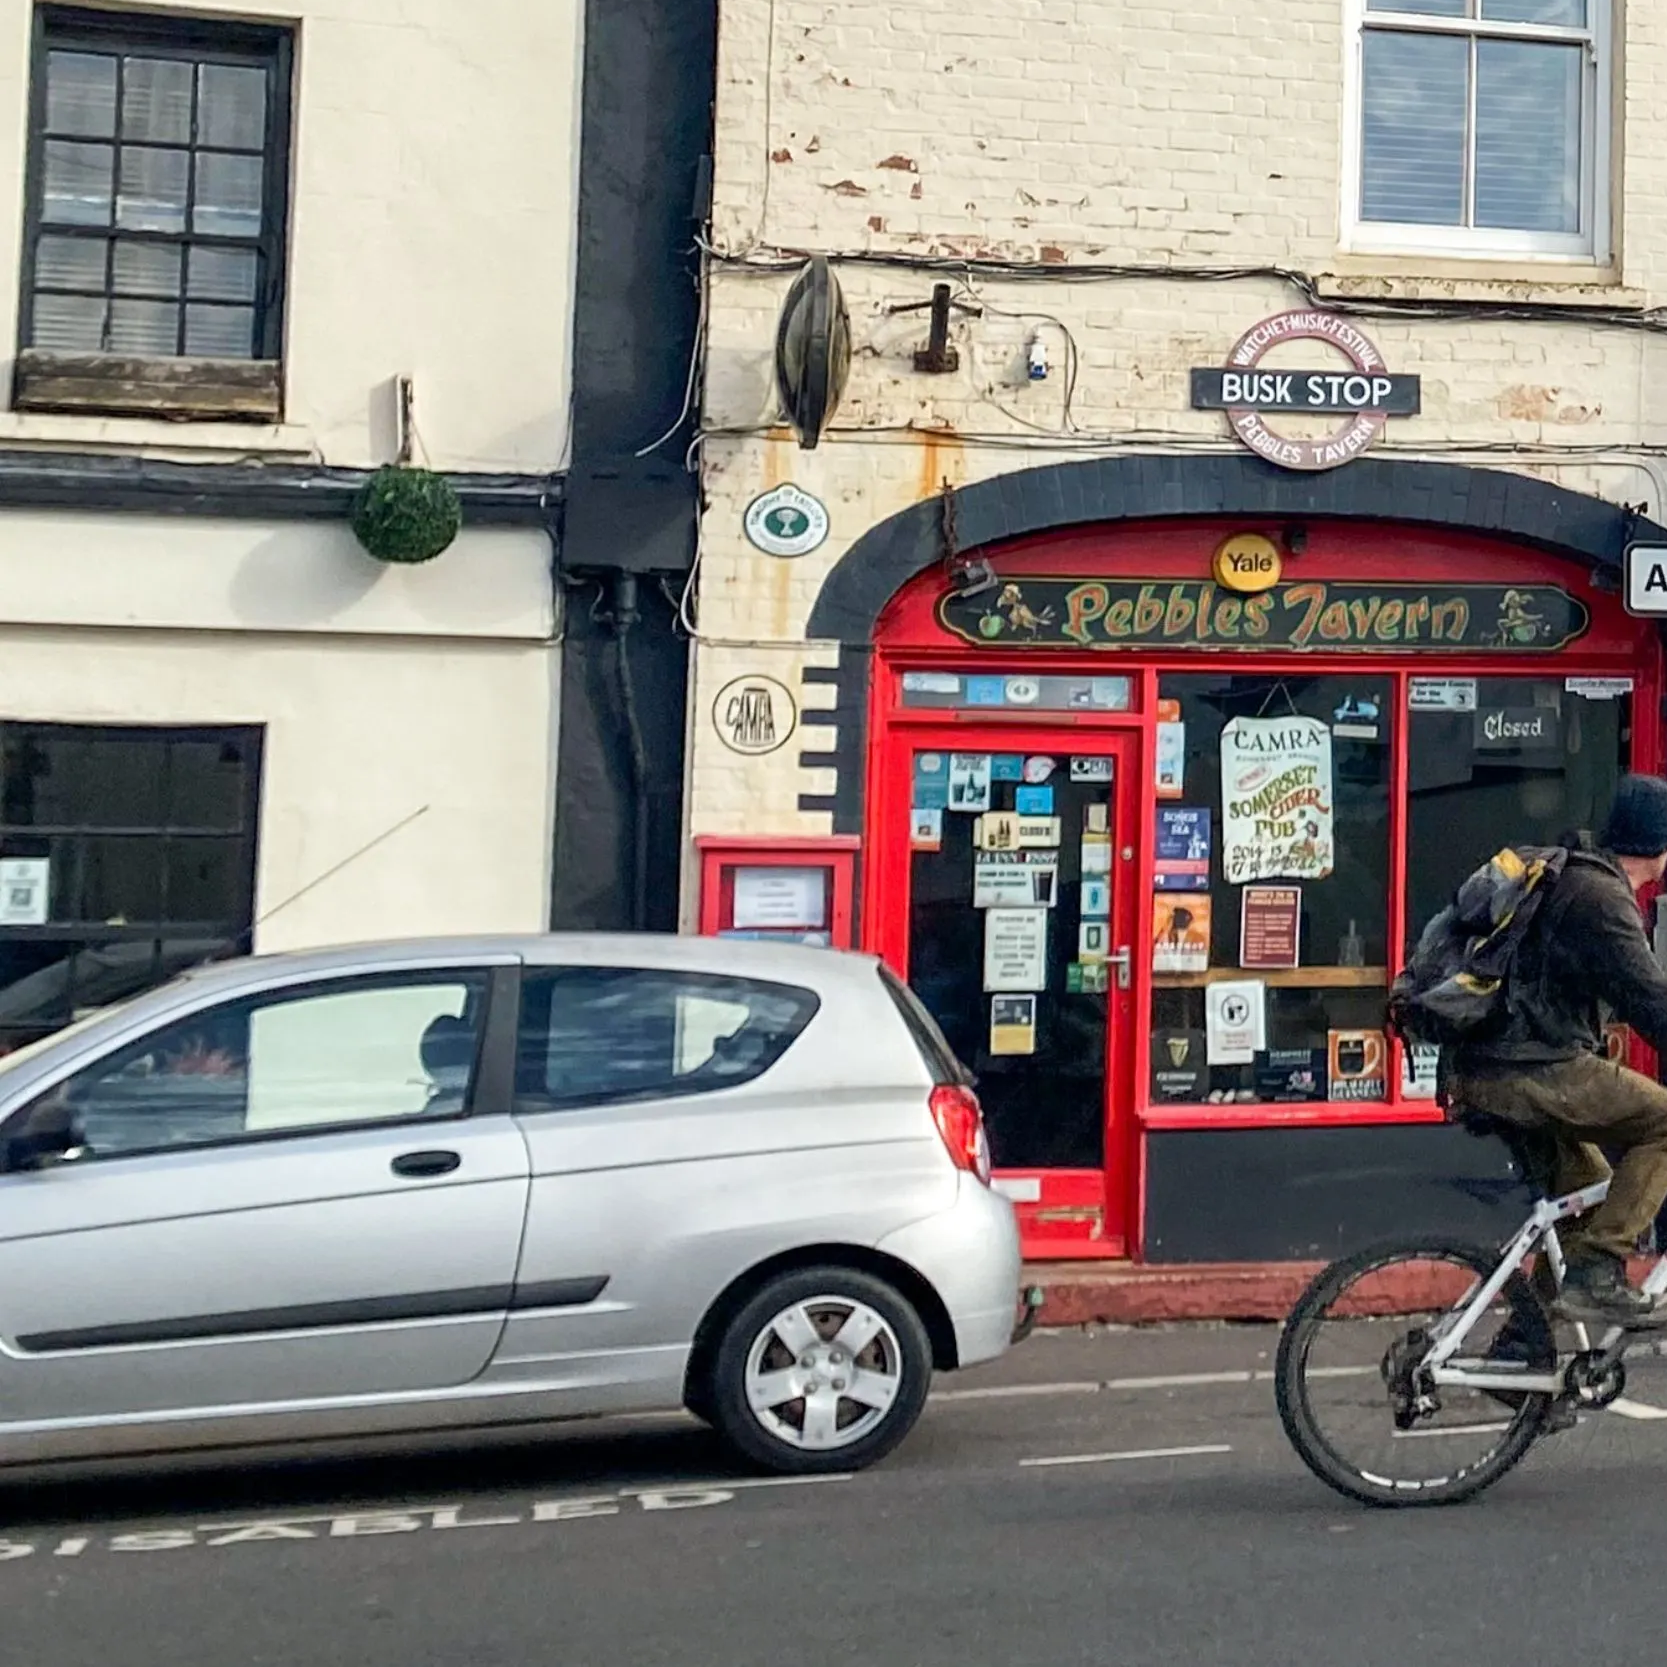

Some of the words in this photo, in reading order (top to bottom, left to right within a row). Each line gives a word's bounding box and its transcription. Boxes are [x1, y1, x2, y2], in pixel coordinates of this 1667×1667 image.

[1330, 320, 1380, 373] FESTIVAL
[1221, 373, 1293, 404] BUSK
[1306, 375, 1393, 406] STOP
[1238, 414, 1301, 464] PEBBLES
[1312, 419, 1376, 464] TAVERN
[1227, 553, 1273, 573] Yale
[1062, 582, 1275, 645] Pebbles
[1283, 583, 1471, 647] Tavern
[1234, 729, 1322, 753] CAMRA
[1483, 710, 1543, 741] Closed
[1229, 764, 1318, 820] SOMERSET
[1269, 787, 1330, 821] CIDER
[1254, 818, 1297, 840] PUB
